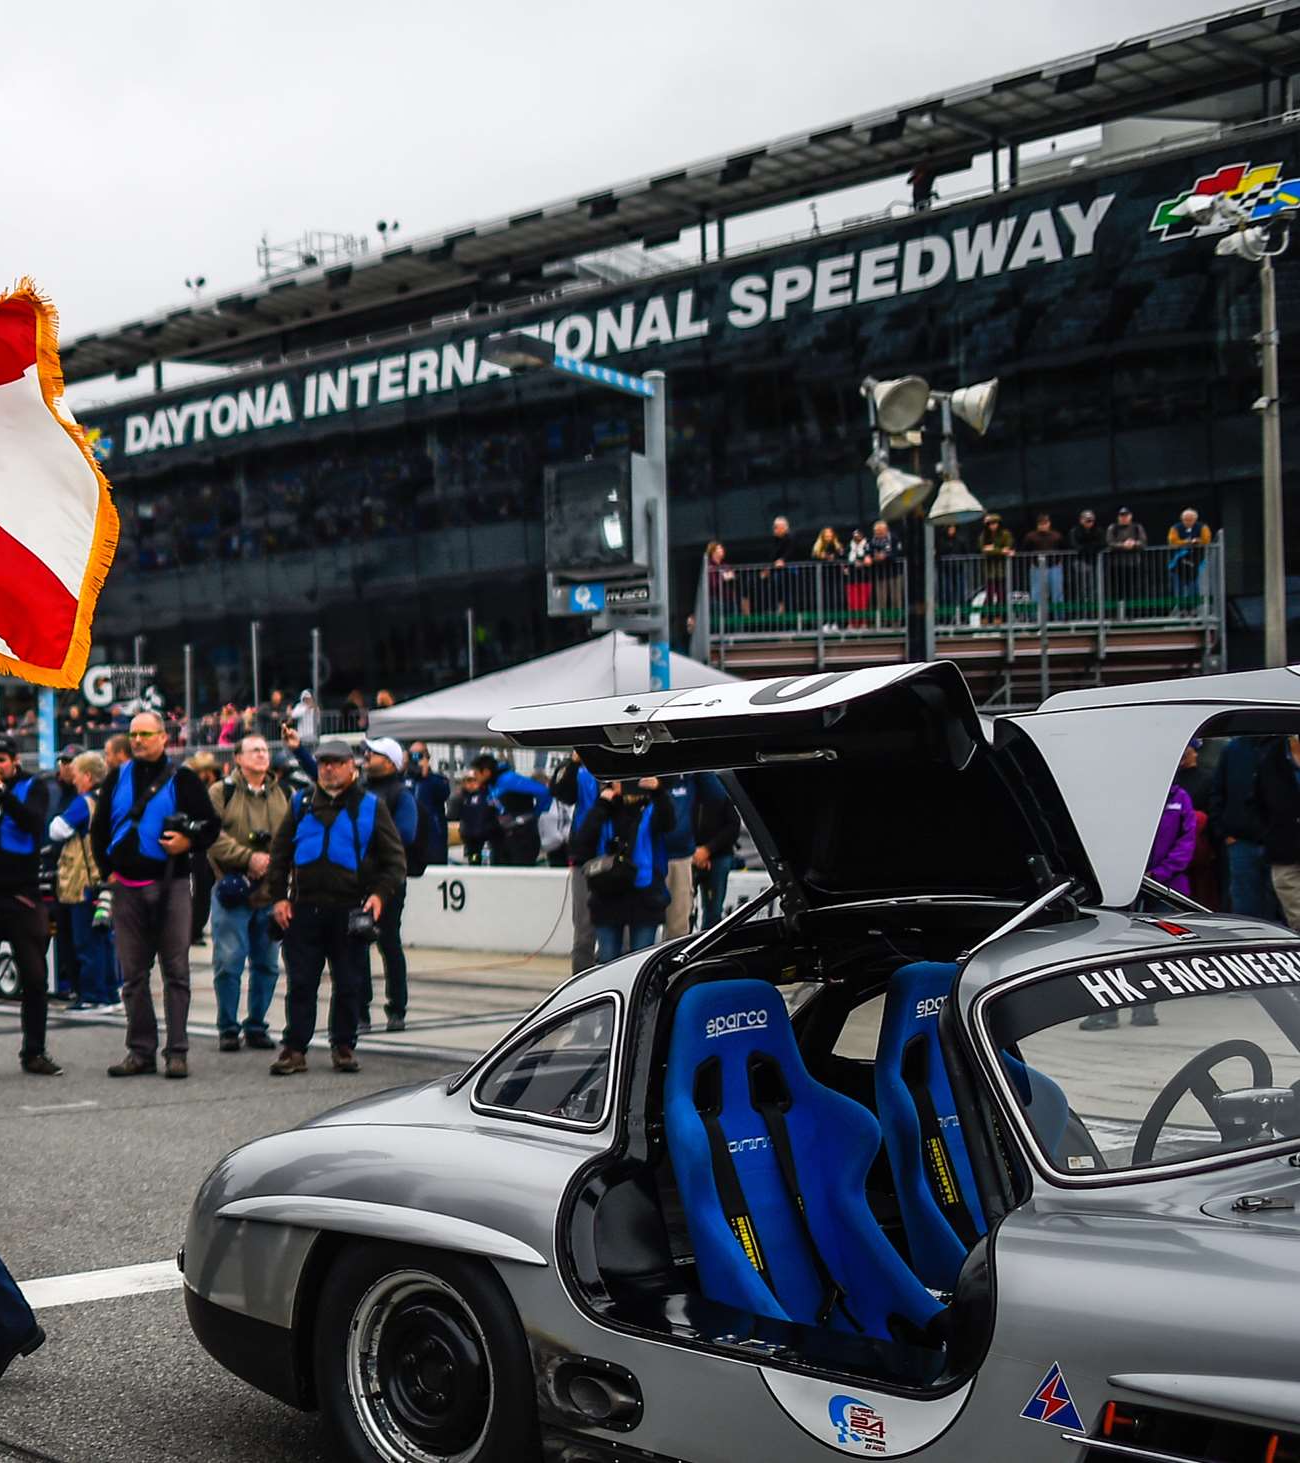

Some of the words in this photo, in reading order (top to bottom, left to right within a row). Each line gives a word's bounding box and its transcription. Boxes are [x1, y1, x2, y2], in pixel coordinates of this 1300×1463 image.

[125, 383, 292, 455] DAYTONA
[303, 288, 709, 419] INTERNAONAL
[727, 194, 1115, 329] SPEEDWAY
[438, 879, 466, 912] 19
[1077, 951, 1300, 1008] HK-ENGINEERI
[706, 1009, 768, 1037] sparco
[850, 1416, 886, 1438] 24
